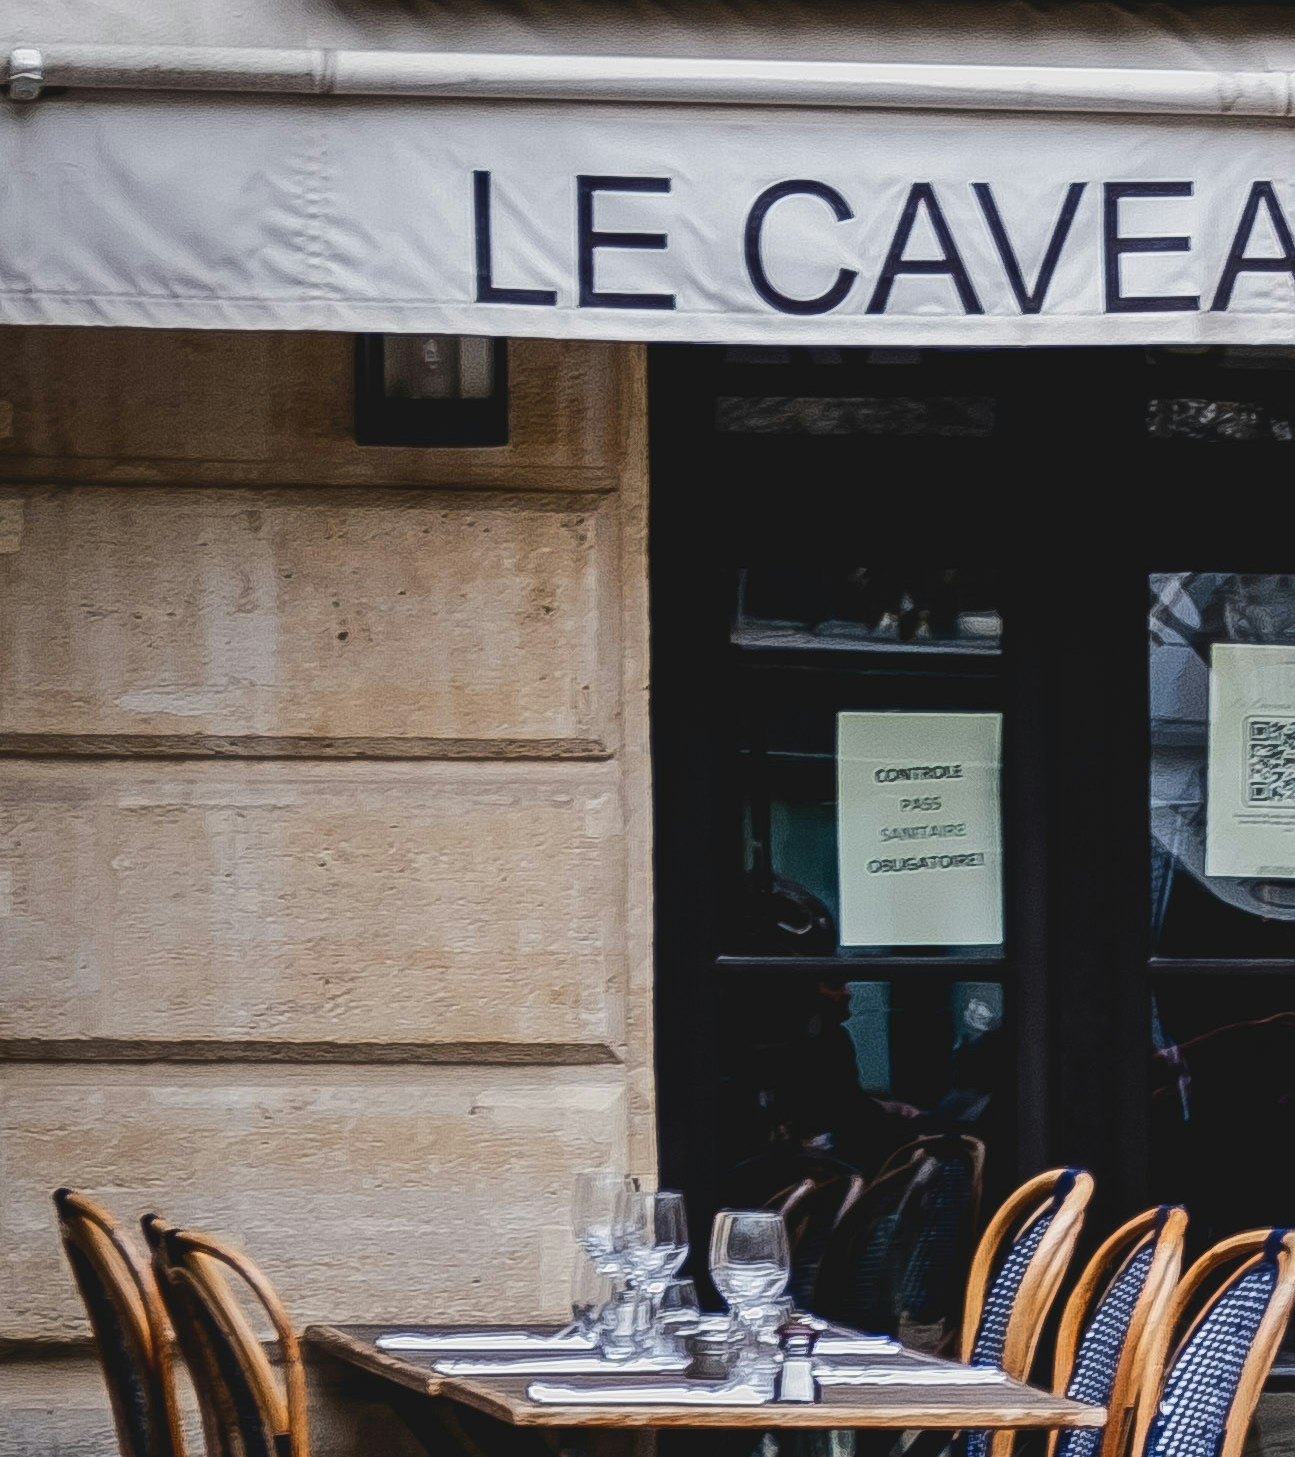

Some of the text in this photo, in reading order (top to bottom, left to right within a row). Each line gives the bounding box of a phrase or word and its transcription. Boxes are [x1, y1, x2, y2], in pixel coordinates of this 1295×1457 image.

[473, 170, 677, 311] LE
[874, 764, 964, 784] CONTROLE
[900, 796, 943, 812] PASS
